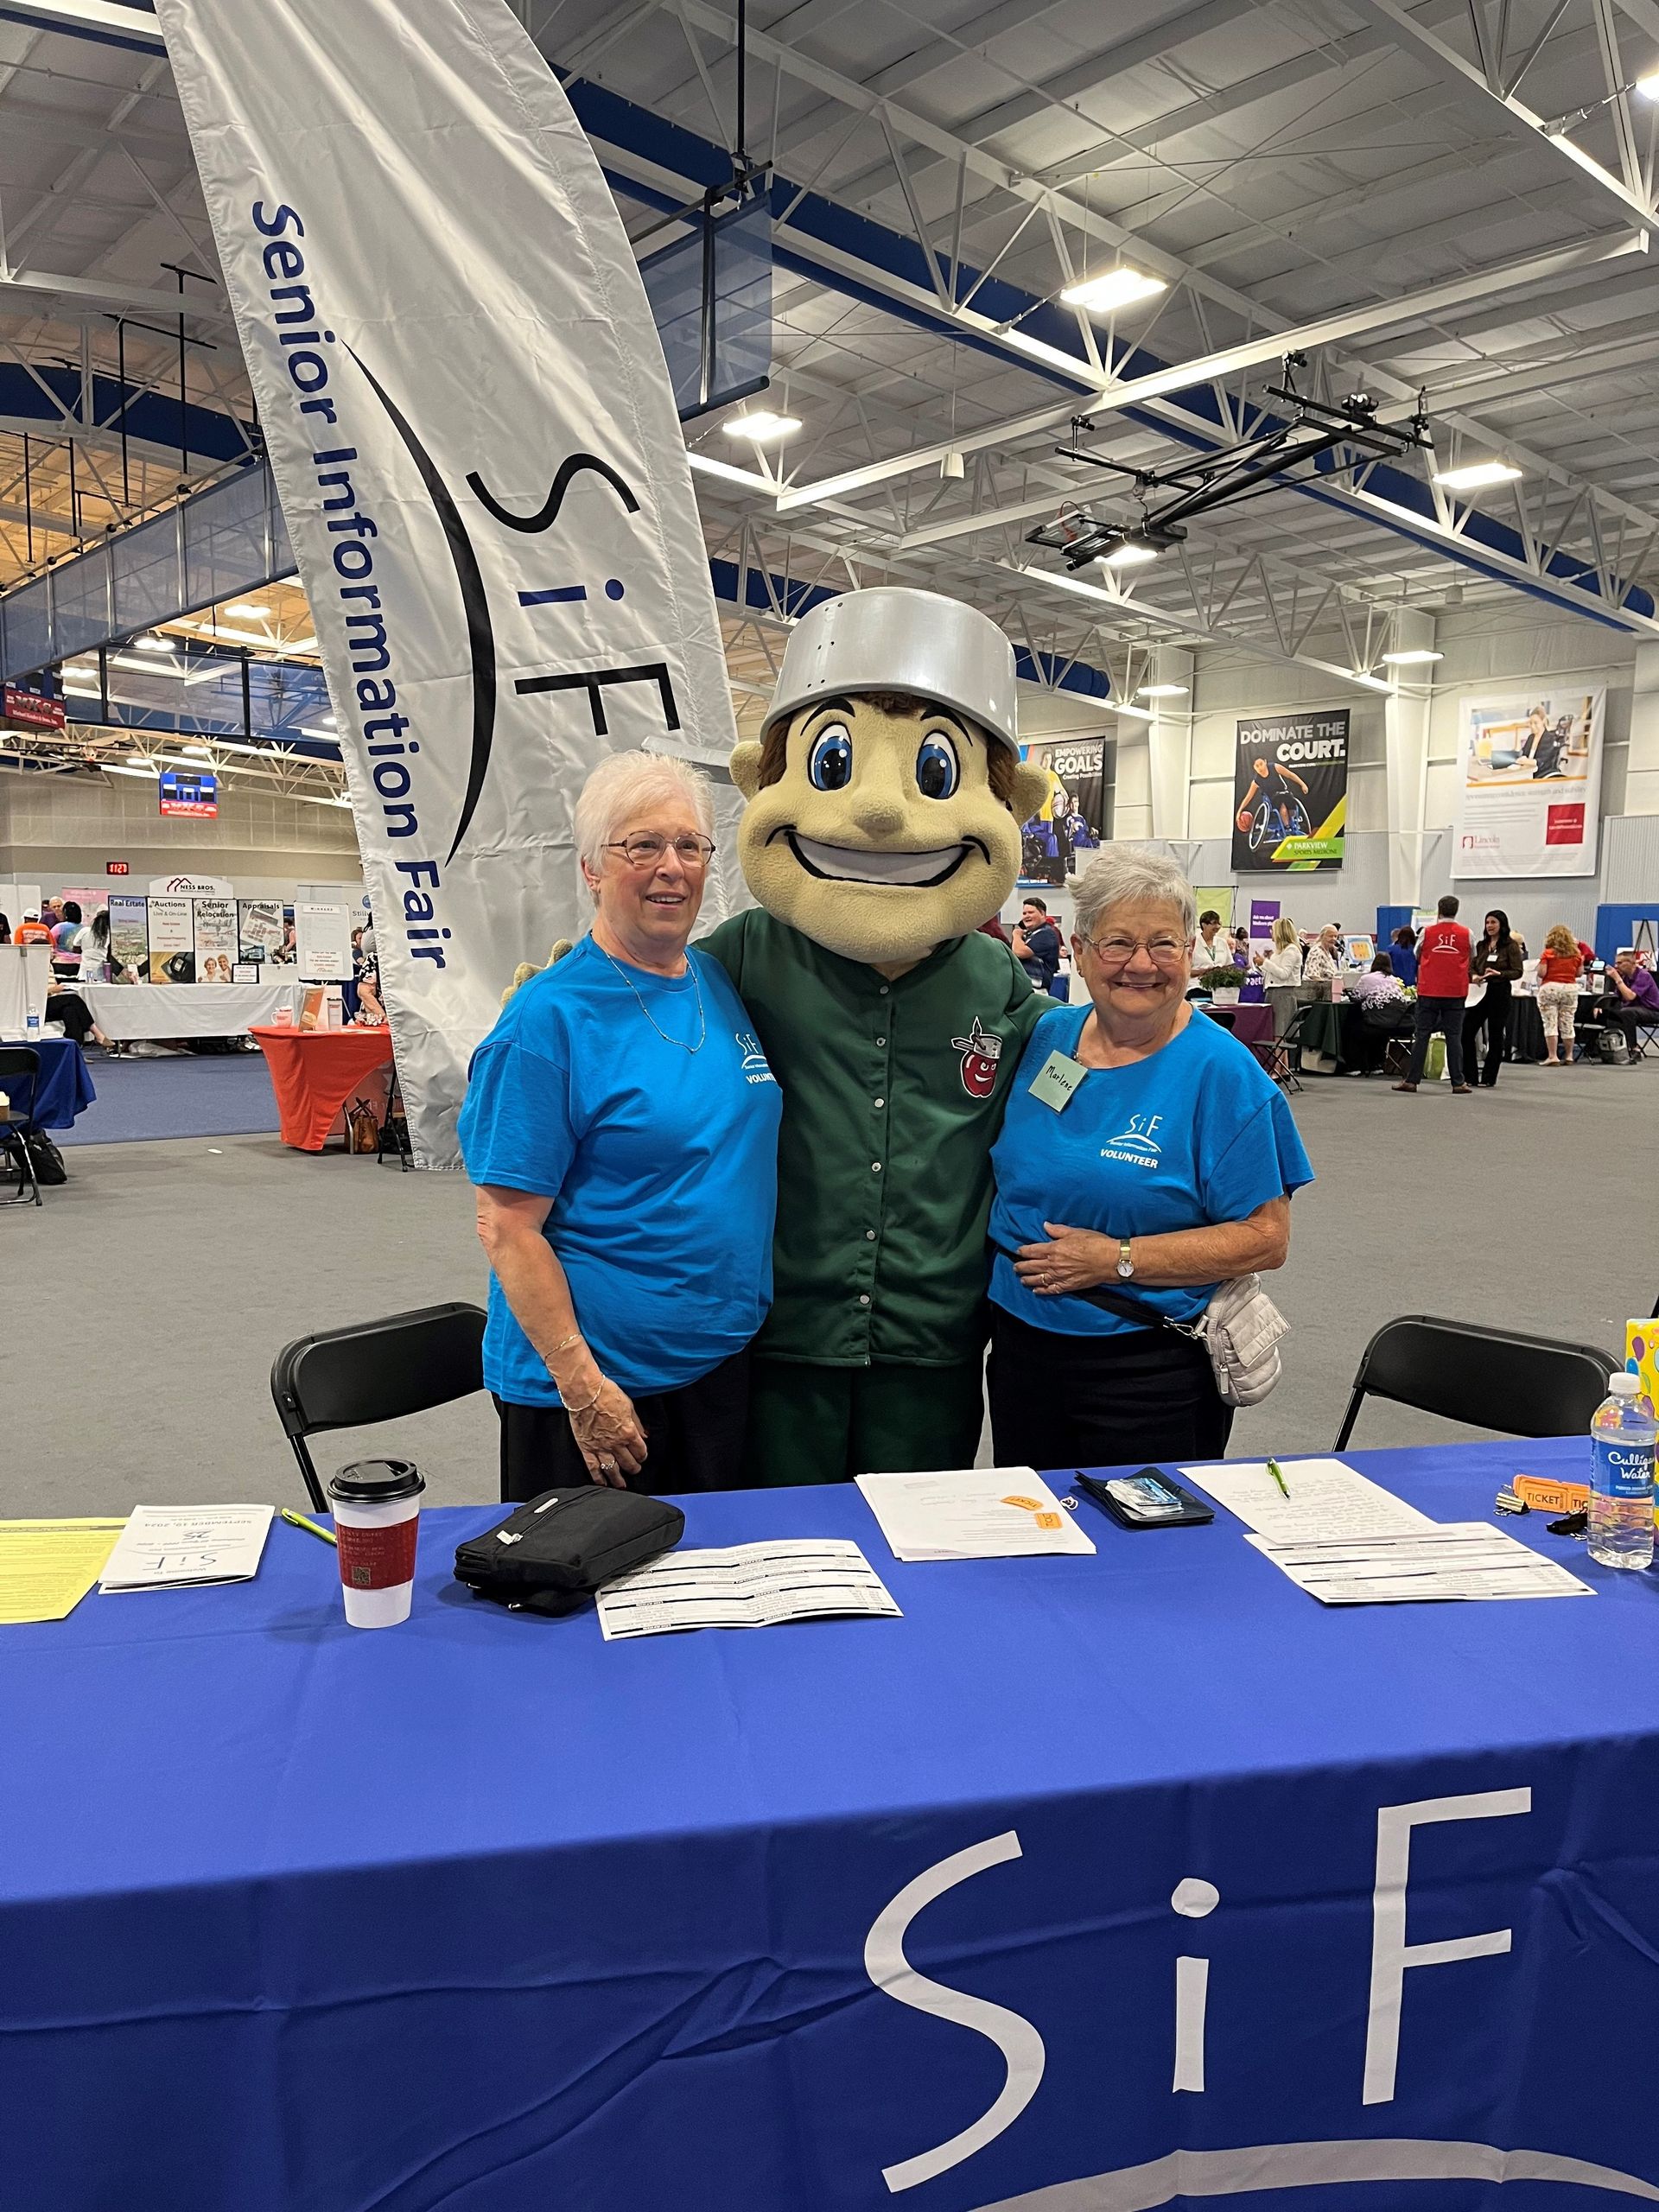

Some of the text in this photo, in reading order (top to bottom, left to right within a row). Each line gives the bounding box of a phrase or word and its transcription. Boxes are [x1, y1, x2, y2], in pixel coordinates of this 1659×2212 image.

[252, 200, 453, 969] Senior Information Fair
[466, 453, 681, 736] SiF
[1240, 721, 1345, 745] DOMINATE THE
[1054, 744, 1103, 757] EMPOWERING
[1276, 739, 1345, 762] COURT.
[1054, 753, 1103, 775] GOALS
[1294, 841, 1328, 850] PARKVIEW
[1438, 933, 1456, 946] SiF
[735, 1032, 760, 1056] SiF
[1045, 1065, 1072, 1092] Marlene
[1124, 1113, 1163, 1137] SiF
[1100, 1148, 1159, 1169] VOLUNTEER
[1620, 1467, 1651, 1479] Water
[1527, 1492, 1560, 1505] TICKET
[1573, 1498, 1589, 1510] TIC
[142, 1552, 218, 1571] SiF
[864, 1786, 1532, 2193] SiF
